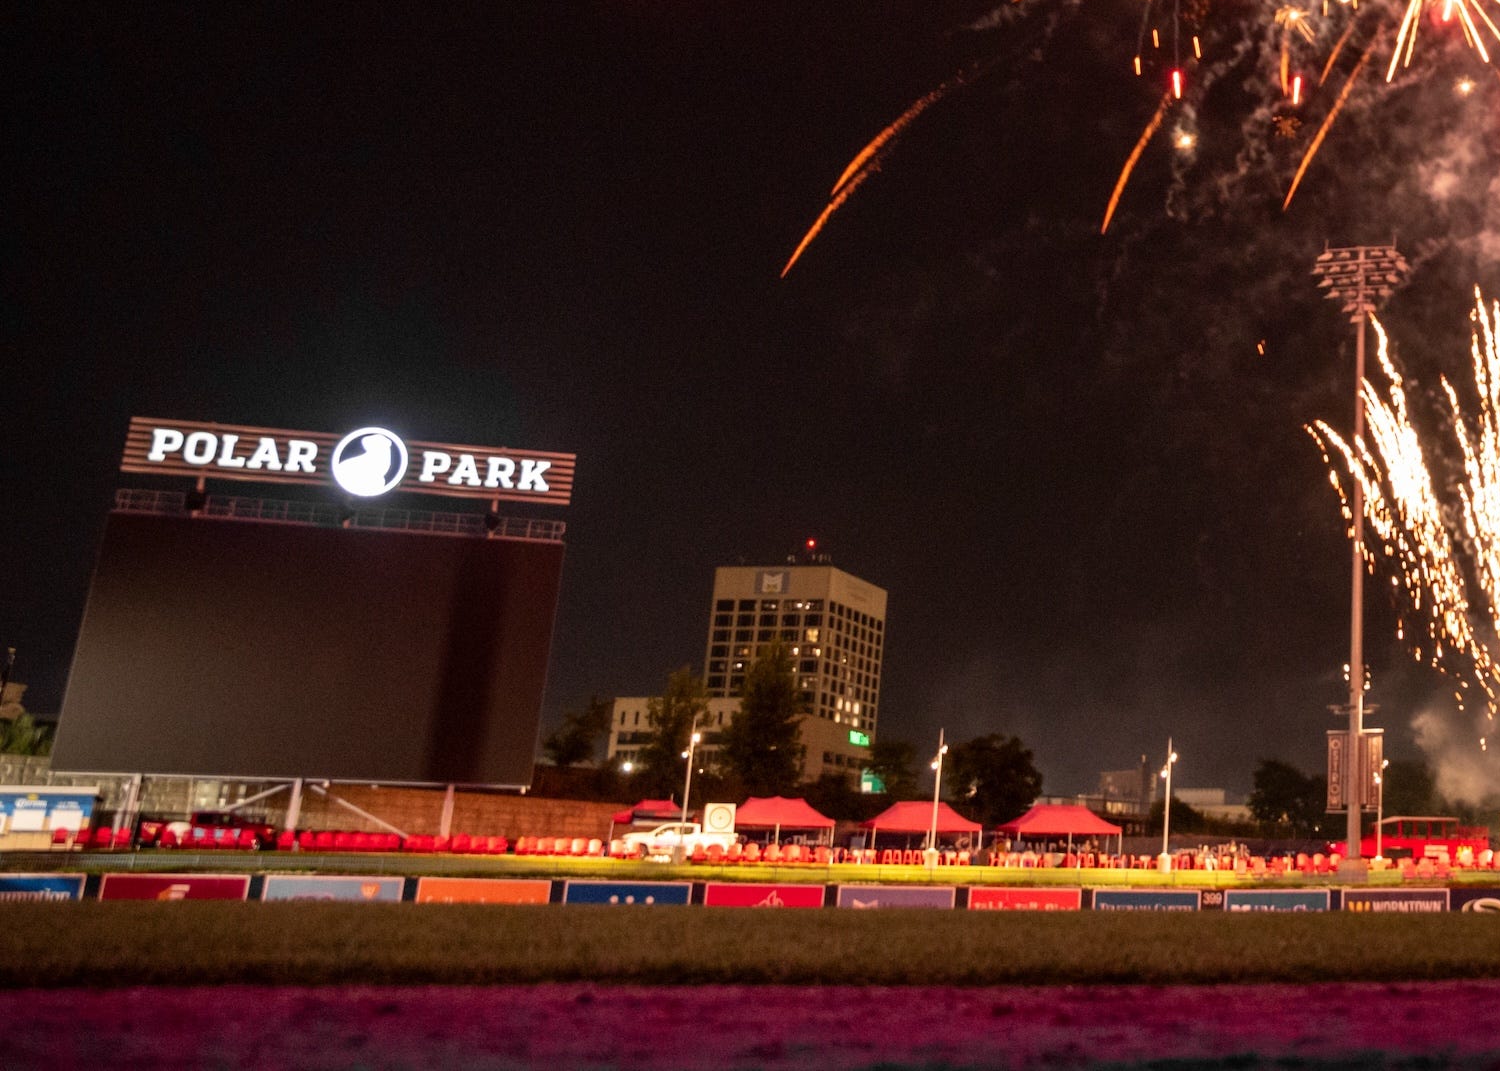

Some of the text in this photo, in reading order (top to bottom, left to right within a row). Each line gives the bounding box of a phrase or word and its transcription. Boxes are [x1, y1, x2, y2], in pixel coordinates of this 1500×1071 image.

[148, 428, 553, 492] POLAR PARK
[1203, 892, 1223, 905] 399
